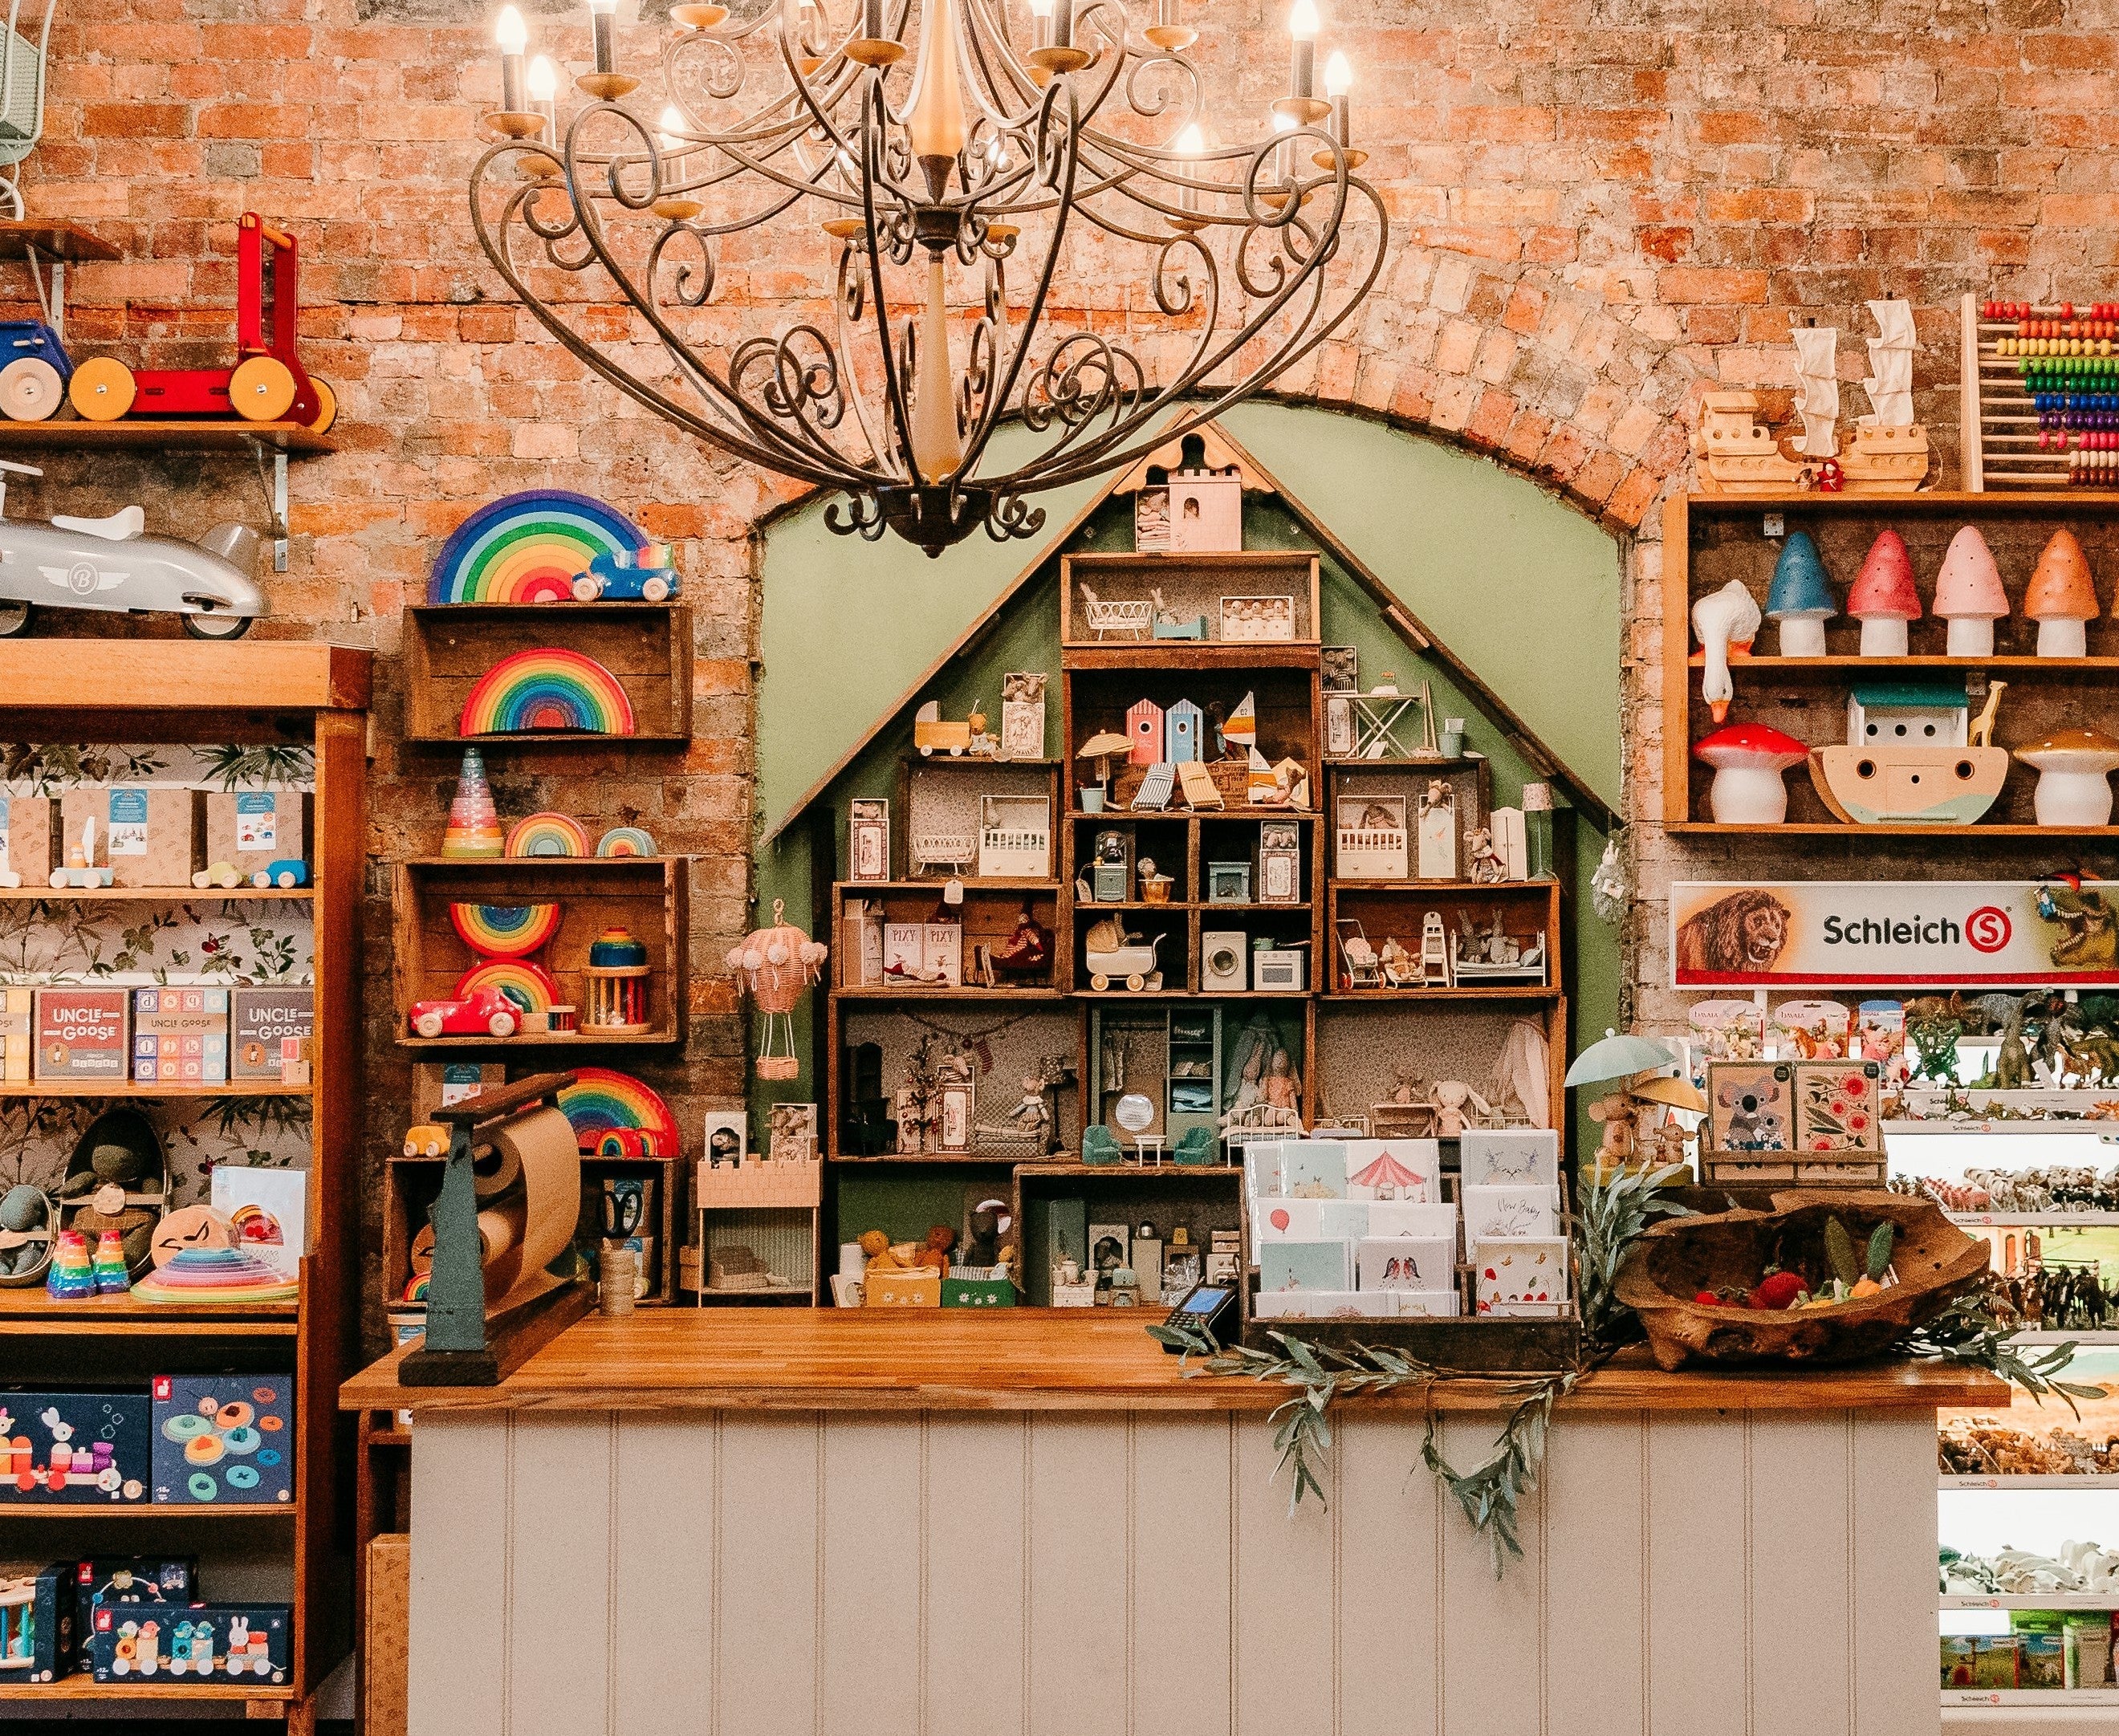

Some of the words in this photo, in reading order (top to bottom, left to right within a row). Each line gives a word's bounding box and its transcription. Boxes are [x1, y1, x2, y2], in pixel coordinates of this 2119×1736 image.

[74, 569, 91, 588] B
[892, 929, 917, 942] PIXY
[930, 929, 954, 943] PIXY
[1823, 914, 1960, 945] Schleich
[53, 1008, 103, 1023] UNCLE
[249, 1008, 298, 1023] UNCLE
[150, 1019, 177, 1028] UNCLE
[181, 1019, 211, 1028] GOOSE
[62, 1026, 117, 1041] GOOSE
[258, 1025, 312, 1040] GOOSE
